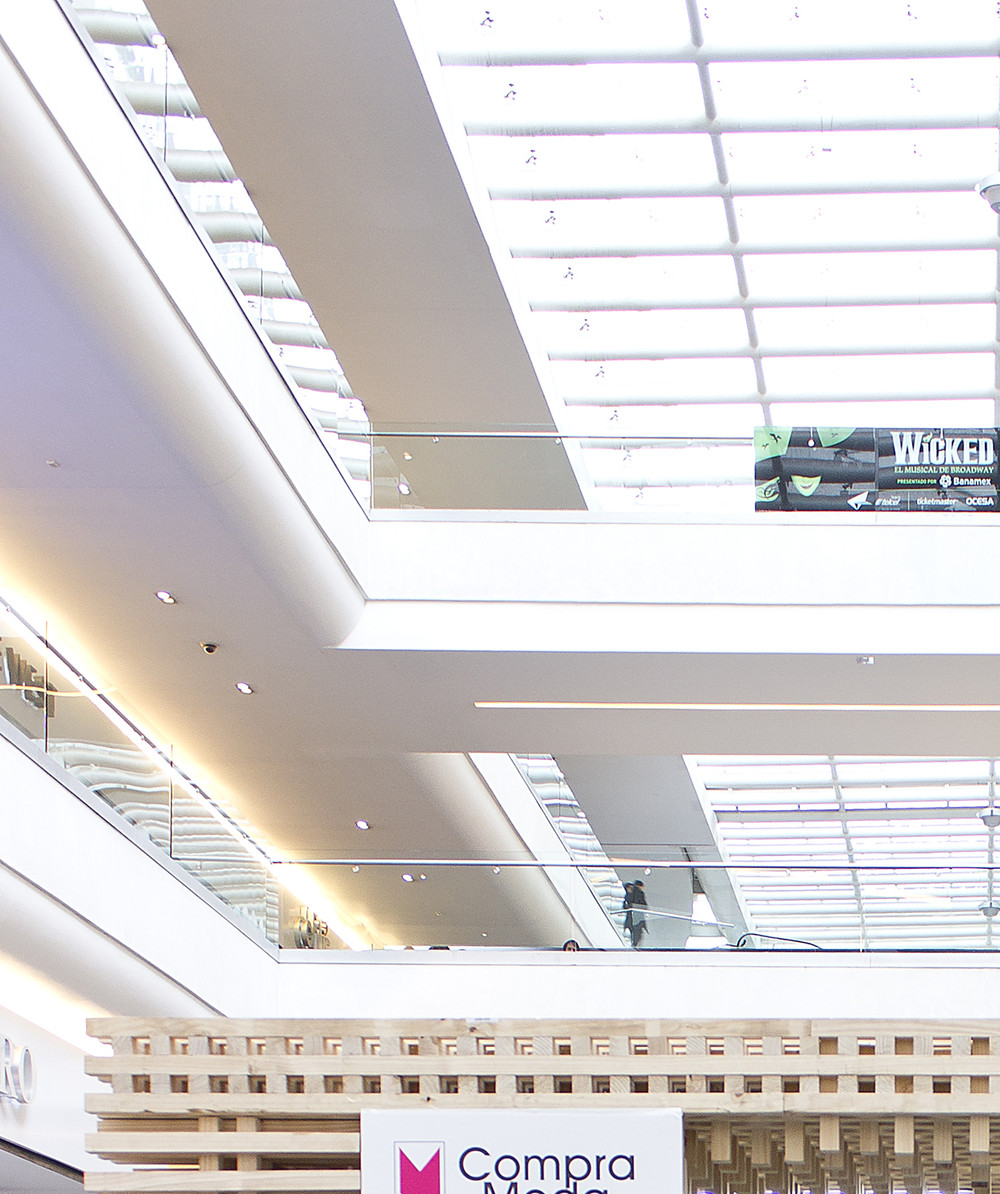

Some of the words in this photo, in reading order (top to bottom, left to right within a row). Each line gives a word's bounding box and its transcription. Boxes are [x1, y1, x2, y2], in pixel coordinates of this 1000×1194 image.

[894, 466, 903, 474] EL
[904, 466, 938, 474] MUSICAL
[939, 466, 950, 474] DE
[950, 466, 994, 474] BROADWAY
[953, 476, 992, 486] Banamex
[458, 1147, 636, 1188] Compra
